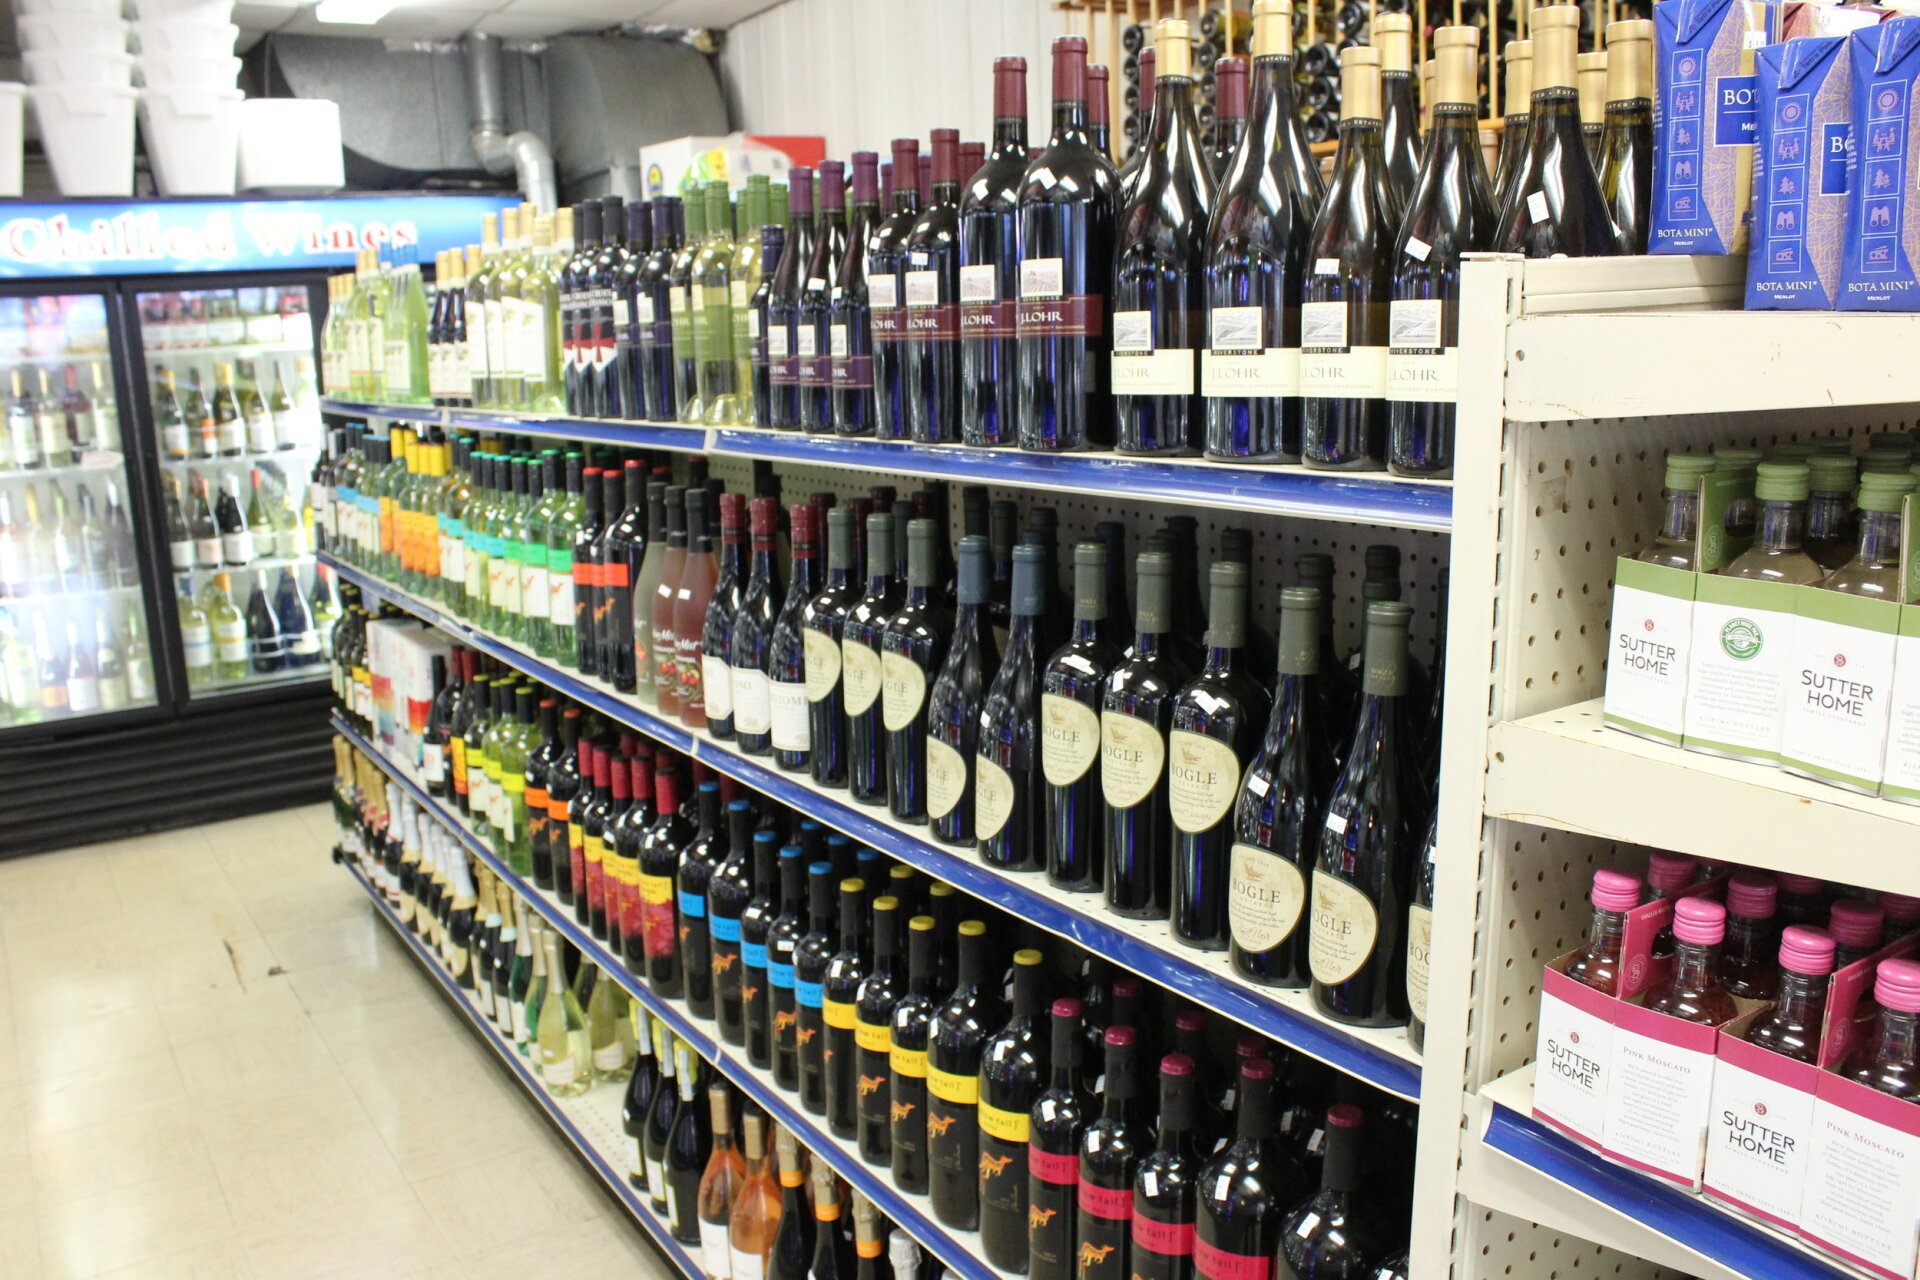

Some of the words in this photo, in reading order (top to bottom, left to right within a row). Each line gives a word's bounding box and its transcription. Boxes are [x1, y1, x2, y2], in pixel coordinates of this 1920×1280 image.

[5, 211, 238, 264] Chilled
[242, 209, 418, 259] Wines
[1657, 228, 1683, 238] BOTA
[1684, 227, 1709, 237] MINI
[1756, 281, 1784, 292] BOTA
[1786, 280, 1813, 291] MINI
[1848, 282, 1877, 293] BOTA
[1879, 281, 1910, 292] MINI
[1619, 633, 1676, 662] SUTTER
[1624, 652, 1669, 676] HOME
[1801, 669, 1874, 701] SUTTER
[1807, 690, 1864, 717] HOME
[1312, 908, 1352, 936] OGLE
[1547, 1038, 1601, 1078] SUTTER
[1552, 1056, 1594, 1089] HOME
[1623, 1046, 1644, 1060] PINK
[1647, 1054, 1692, 1075] MOSCATO
[1722, 1110, 1796, 1153] SUTTER
[1826, 1120, 1851, 1138] PINK
[1853, 1132, 1905, 1160] MOSCATO
[1729, 1130, 1787, 1165] HOME
